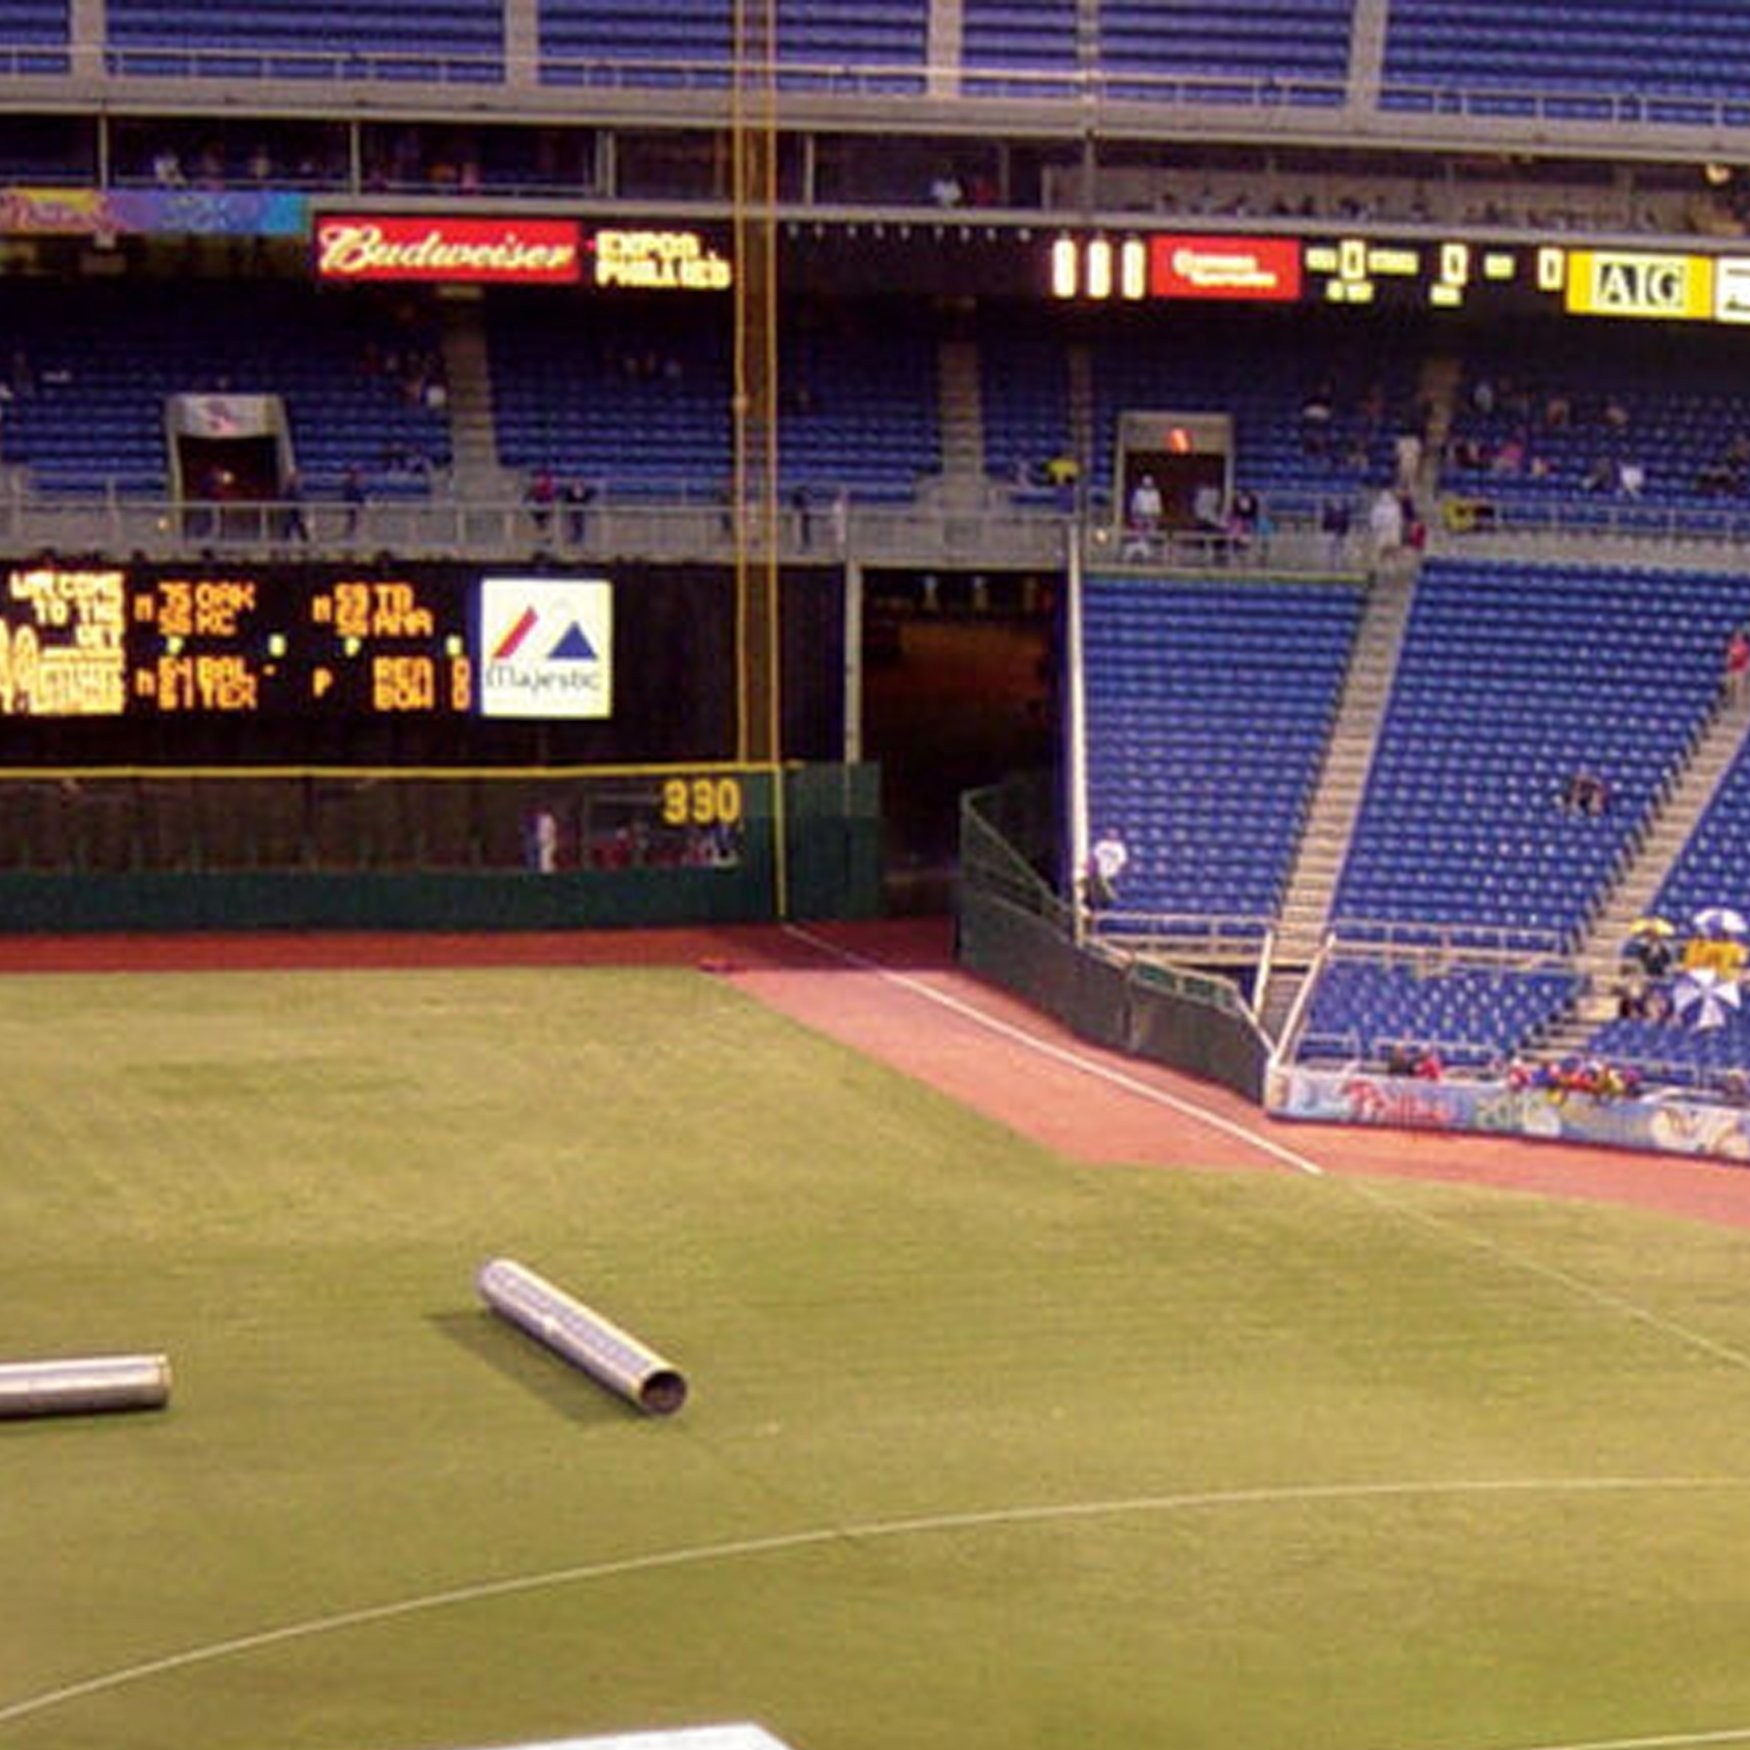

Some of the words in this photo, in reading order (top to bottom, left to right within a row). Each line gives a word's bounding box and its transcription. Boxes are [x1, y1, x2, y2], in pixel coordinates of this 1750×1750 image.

[319, 223, 576, 274] Budweiser
[1599, 261, 1685, 306] AIG
[486, 663, 599, 692] Majestic
[663, 779, 740, 823] 330
